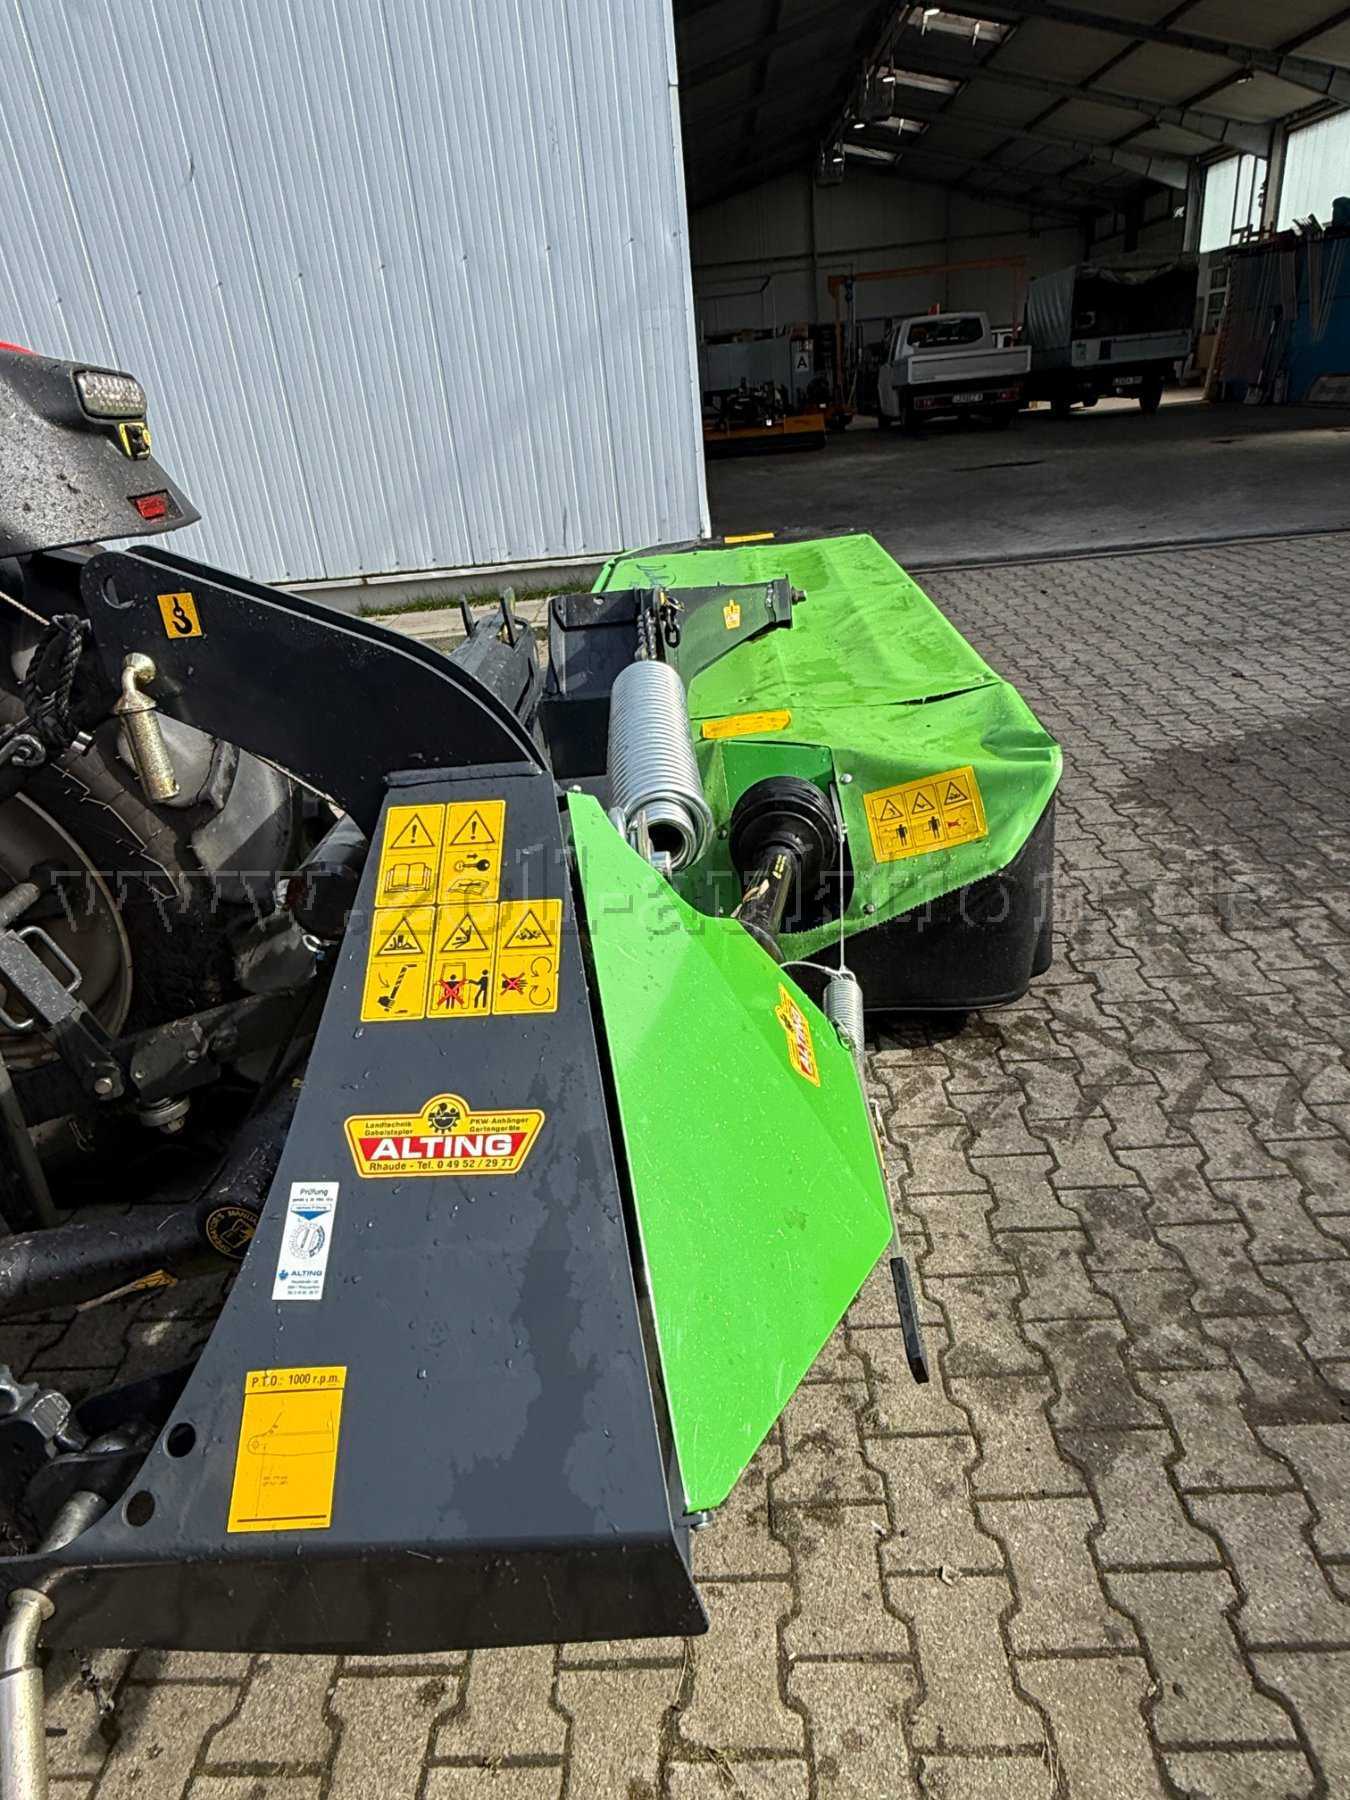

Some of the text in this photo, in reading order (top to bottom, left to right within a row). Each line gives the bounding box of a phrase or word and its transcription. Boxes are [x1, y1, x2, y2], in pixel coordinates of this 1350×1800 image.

[797, 356, 807, 369] A
[370, 1134, 513, 1160] ALTING
[369, 1161, 407, 1171] Rhaude
[417, 1160, 434, 1170] Tel.
[437, 1160, 444, 1169] 0
[446, 1160, 460, 1169] 49
[462, 1159, 475, 1168] 52
[485, 1159, 498, 1168] 29
[501, 1158, 514, 1167] 77
[289, 1373, 311, 1385] 1000
[312, 1374, 340, 1386] r.p.m.
